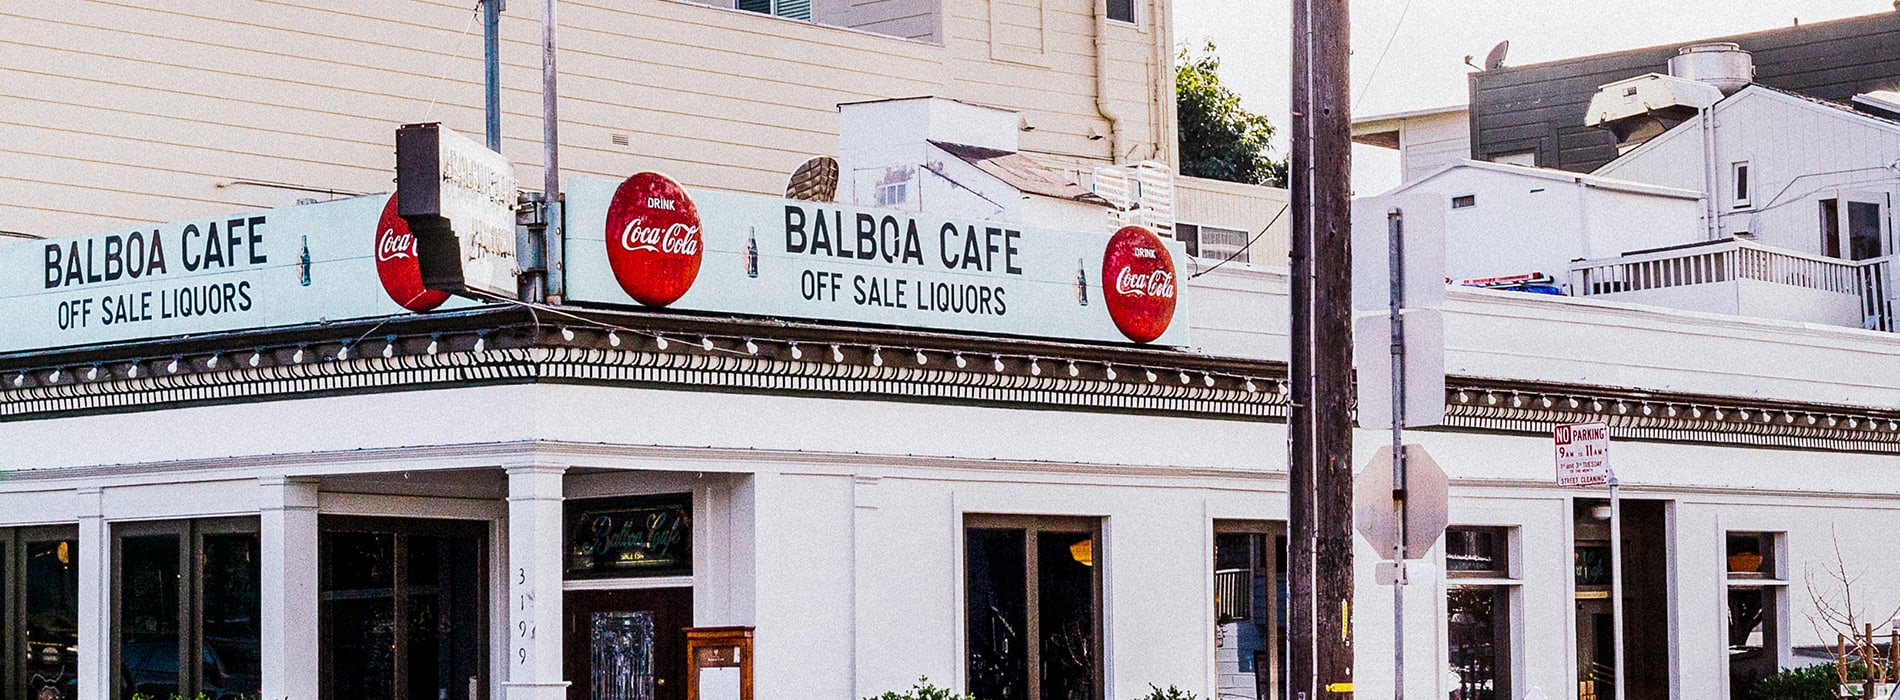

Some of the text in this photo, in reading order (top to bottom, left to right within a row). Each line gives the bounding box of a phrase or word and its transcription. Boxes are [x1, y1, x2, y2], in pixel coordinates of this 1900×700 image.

[647, 197, 676, 211] DRINK
[44, 216, 268, 289] BALBOA CAFE
[621, 218, 699, 256] Coca-Cola
[784, 205, 1023, 275] BALBOA CAFE
[1134, 247, 1157, 259] DRINK
[801, 269, 1007, 316] OFF SALE LIQUORS
[1115, 266, 1174, 299] Coca-Cola
[58, 280, 252, 330] OFF SALE LIQUORS
[1556, 426, 1605, 444] NO PARKING
[1561, 475, 1604, 485] STREET CLEANING
[518, 567, 527, 665] 3199
